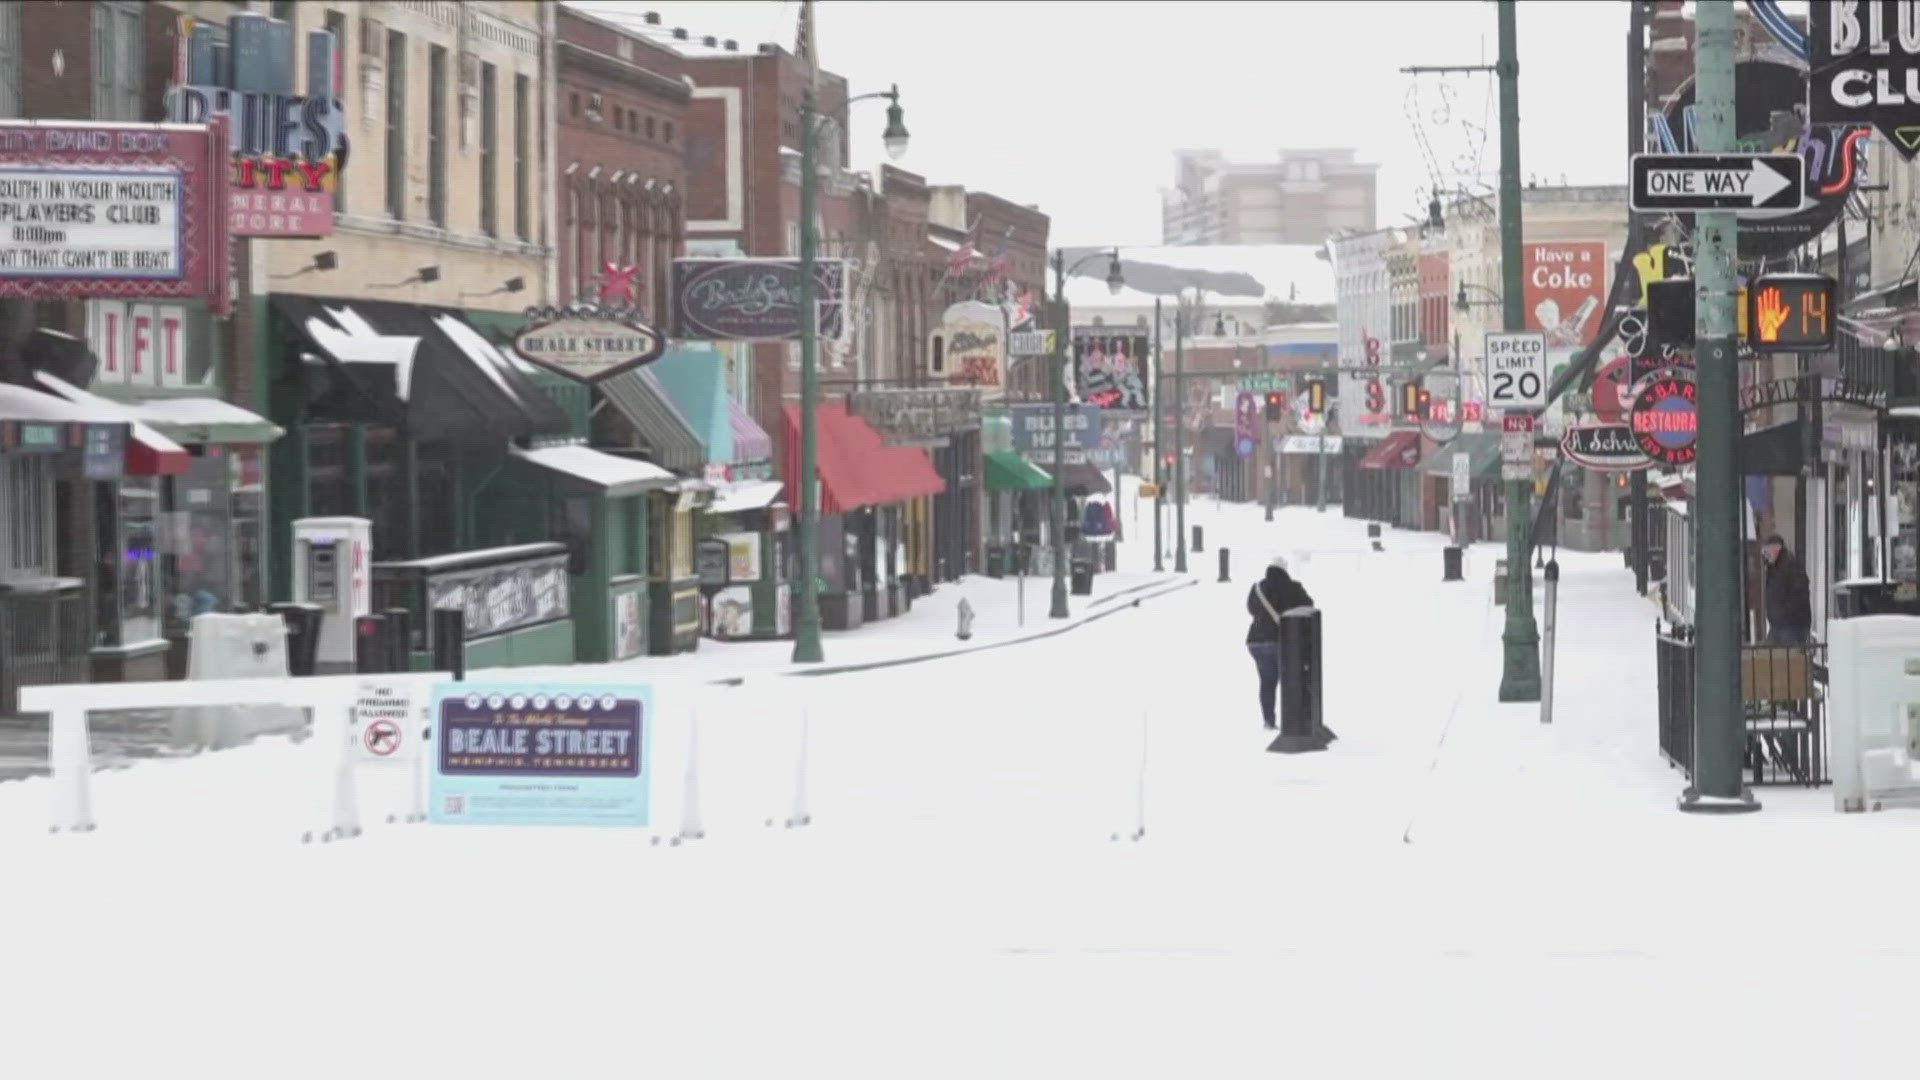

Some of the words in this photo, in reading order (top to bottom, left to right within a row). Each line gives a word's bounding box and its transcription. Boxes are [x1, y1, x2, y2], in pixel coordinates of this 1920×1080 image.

[233, 158, 330, 192] ITY
[1651, 172, 1695, 192] ONE
[1705, 173, 1749, 192] WAY
[69, 182, 112, 200] YOUR
[106, 205, 160, 224] CLUB
[1535, 248, 1576, 263] Have
[1580, 251, 1591, 261] a
[1532, 265, 1593, 289] Coke
[1802, 292, 1828, 336] 14
[104, 313, 181, 375] IFT
[1490, 341, 1541, 354] SPEED
[1496, 356, 1535, 369] LIMIT
[1493, 372, 1541, 399] 20
[1025, 415, 1088, 432] BLES
[1508, 418, 1528, 432] NO
[1633, 412, 1696, 433] RESTAURA
[449, 728, 530, 754] BEALE
[535, 729, 632, 755] STREET
